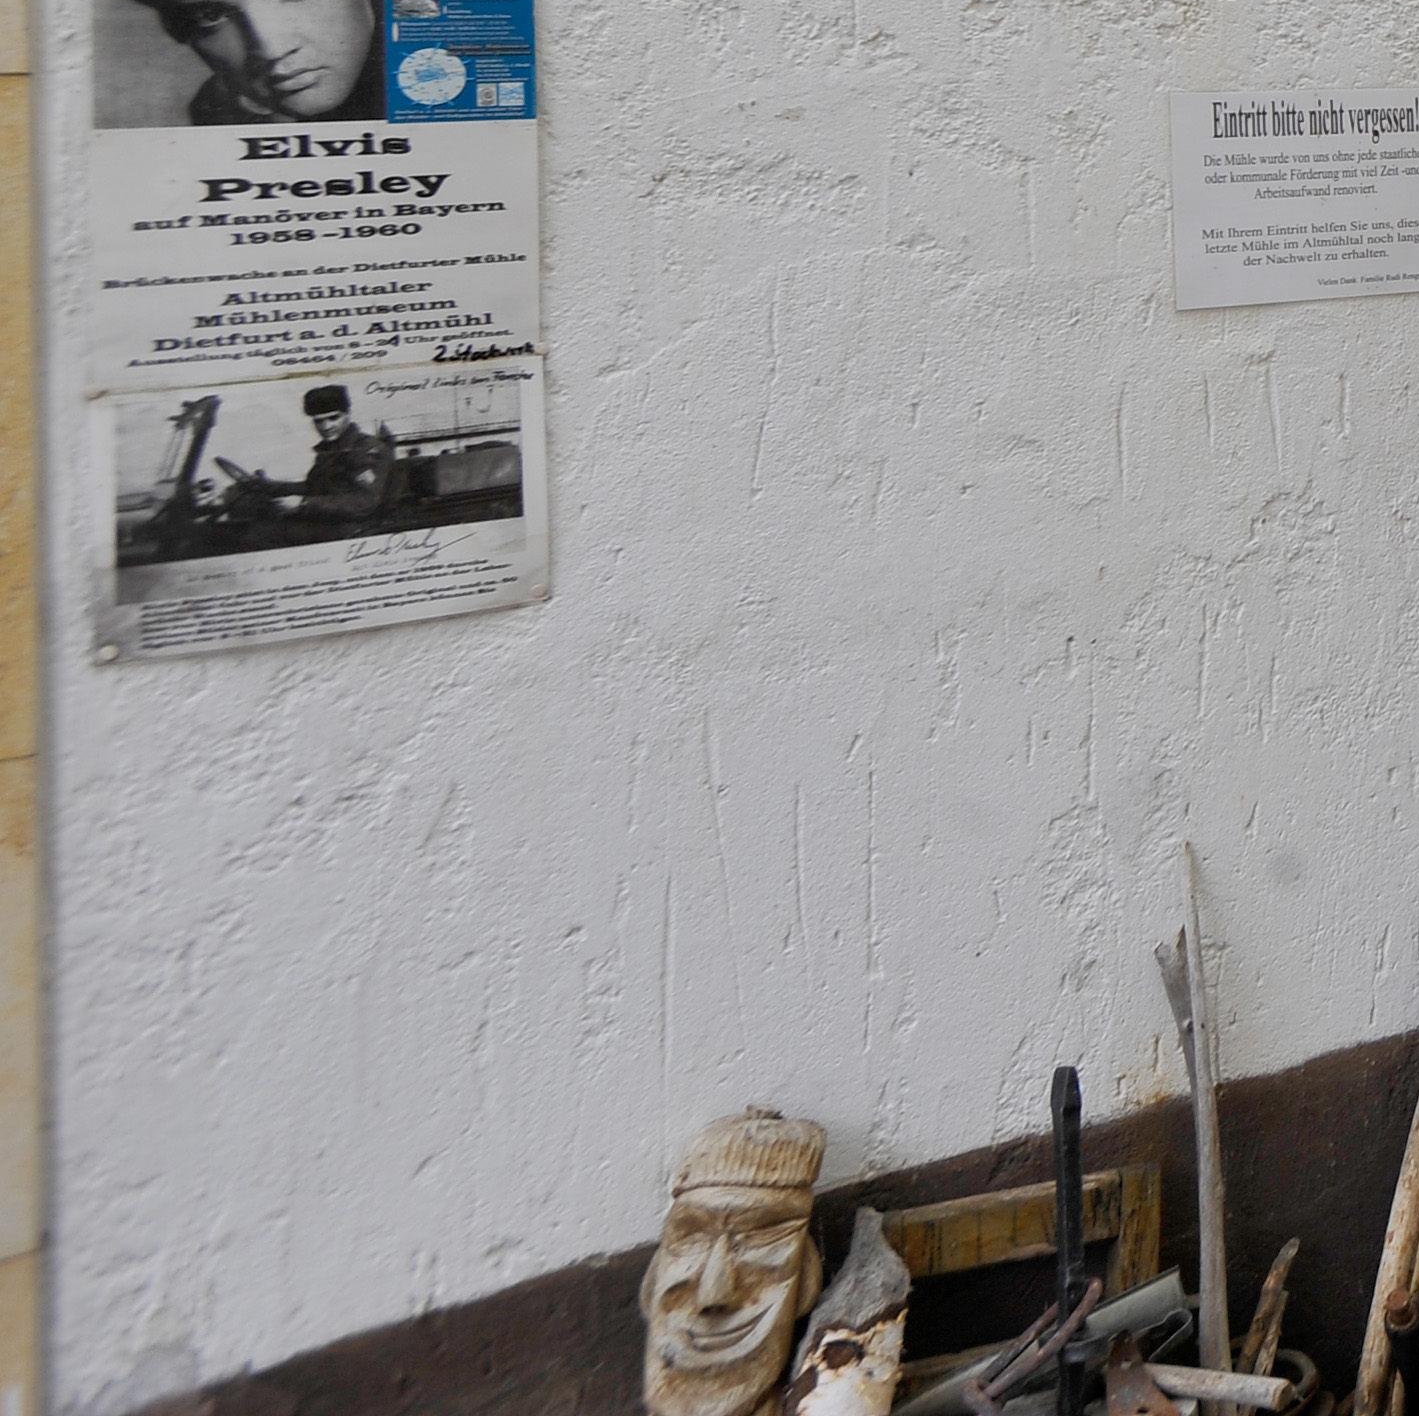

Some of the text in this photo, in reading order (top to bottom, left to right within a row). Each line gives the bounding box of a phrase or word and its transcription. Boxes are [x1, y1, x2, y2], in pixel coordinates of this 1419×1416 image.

[1212, 97, 1419, 144] Eintritt bitte nicht vergessen!
[238, 132, 411, 161] Elvis
[1203, 154, 1221, 167] Die
[1224, 152, 1256, 166] Mühle
[1259, 151, 1289, 164] wurde
[1292, 154, 1310, 163] von
[1312, 153, 1329, 162] uns
[1331, 150, 1354, 162] ohne
[1356, 149, 1377, 164] jede
[198, 170, 452, 203] Presley
[1204, 172, 1226, 184] oder
[1230, 171, 1287, 183] kommunale
[1290, 168, 1339, 184] Förderung
[1342, 168, 1358, 179] mit
[1360, 166, 1377, 177] viel
[1380, 165, 1399, 177] Zeit
[1254, 183, 1378, 200] Arbeitsaufwand renoviert.
[131, 199, 507, 232] auf Manöver in Bayern
[230, 229, 316, 246] 1958
[1202, 227, 1223, 240] Mit
[1228, 226, 1263, 238] Ihrem
[1267, 224, 1307, 236] Eintritt
[1310, 221, 1346, 234] helfen
[1350, 220, 1368, 232] Sie
[1371, 222, 1393, 232] uns,
[1205, 242, 1238, 254] letzte
[1242, 240, 1280, 252] Mühle
[1283, 239, 1299, 250] im
[1302, 235, 1363, 249] Altmühltal
[1366, 233, 1394, 245] noch
[1243, 250, 1390, 266] der Nachwelt zu erhalten.
[101, 253, 527, 291] Brückenwache an der Dietfurter Mühle
[220, 281, 434, 306] Altmühltaler
[193, 297, 458, 329] Mühlenmuseum
[152, 312, 495, 353] Dietfurt a. d. Altmühl
[247, 347, 308, 363] täglich
[312, 344, 344, 354] von
[405, 336, 437, 345] Uhr
